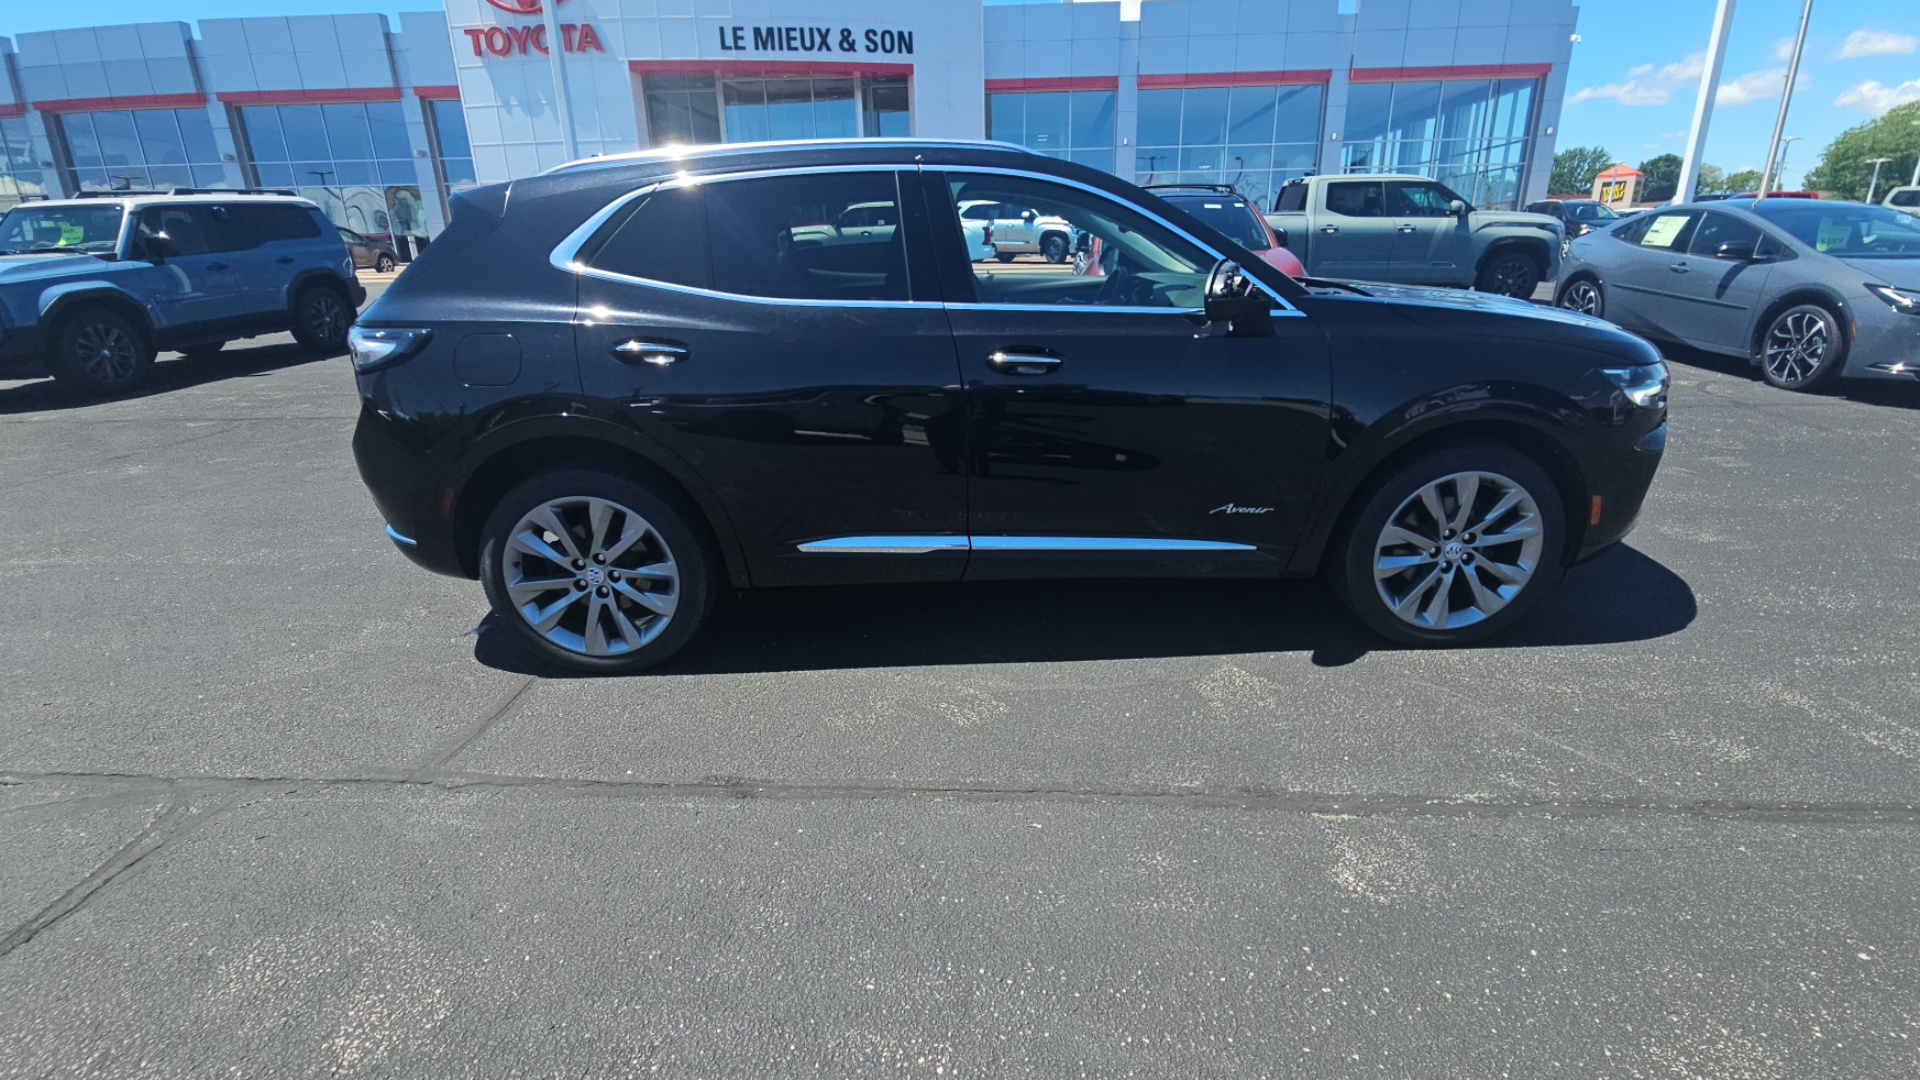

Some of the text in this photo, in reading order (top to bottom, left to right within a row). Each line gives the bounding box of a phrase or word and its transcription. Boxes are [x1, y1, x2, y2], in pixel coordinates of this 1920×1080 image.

[719, 26, 914, 55] LE MIEUX & SON
[1209, 502, 1274, 514] Avenir
